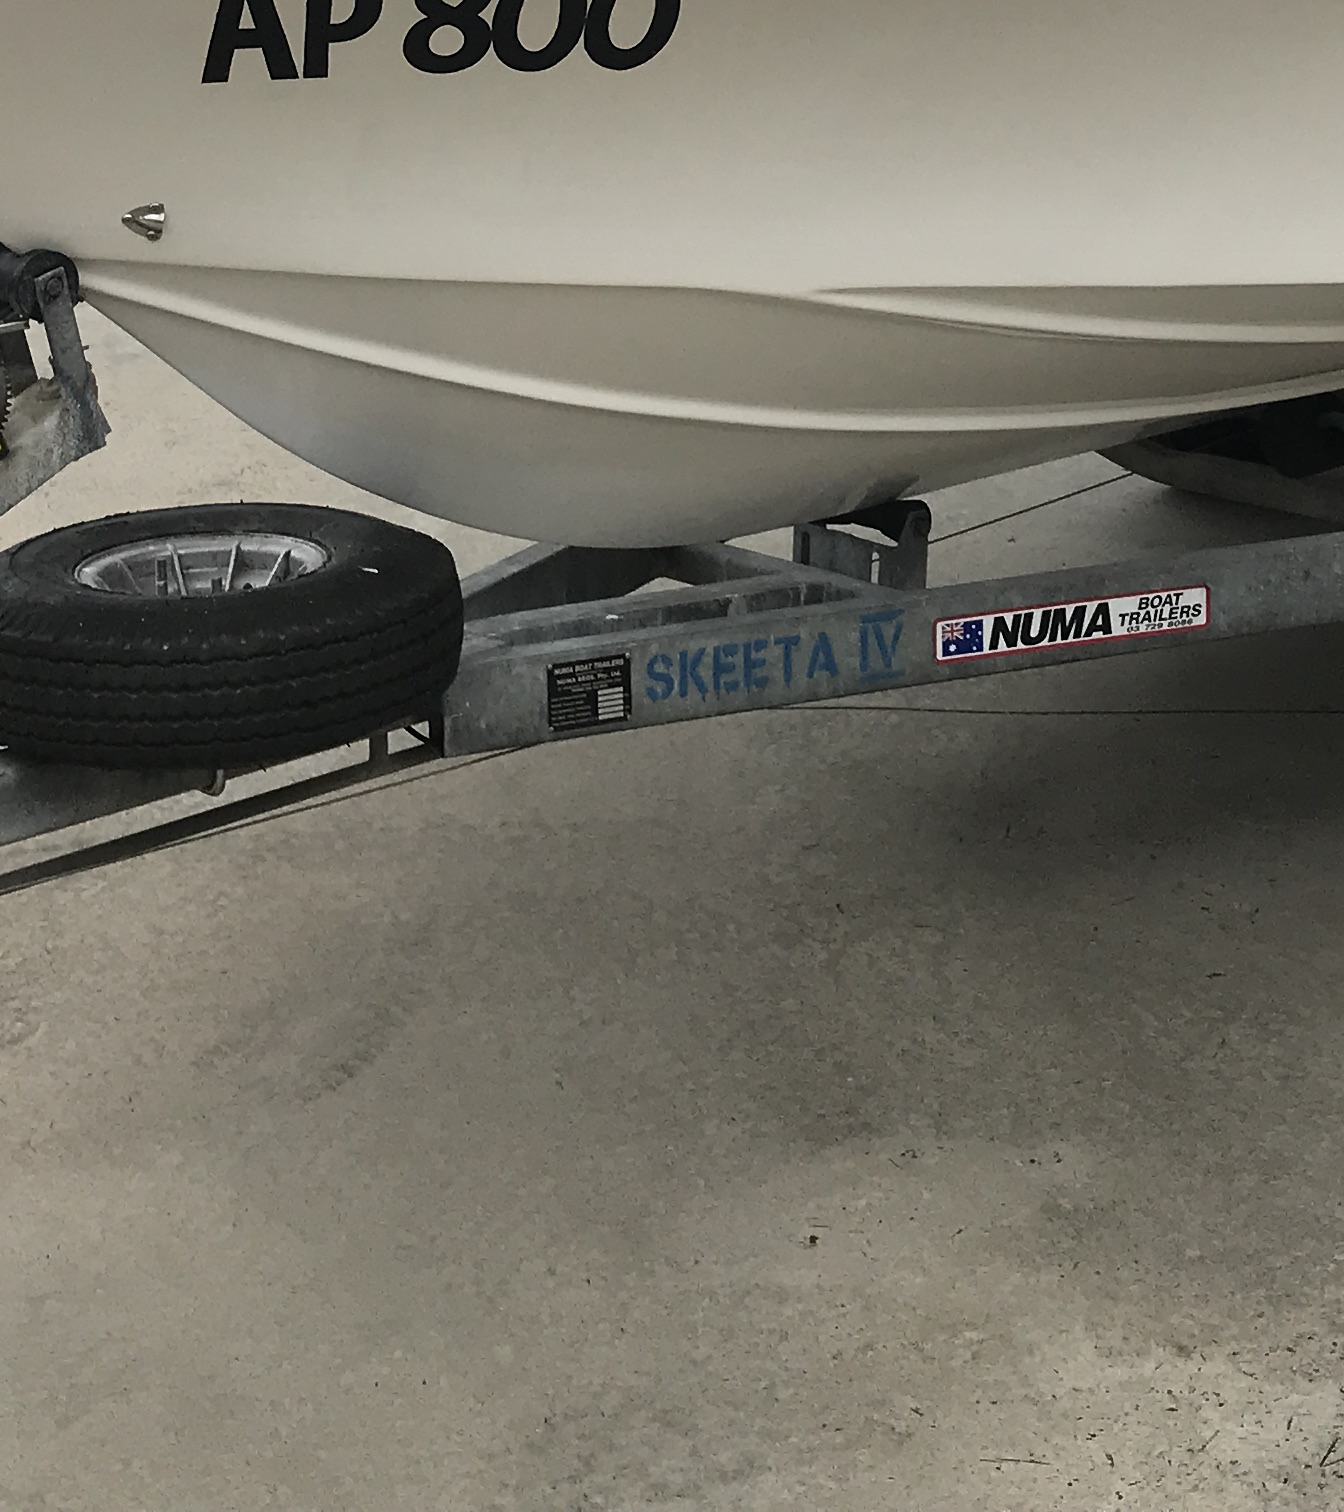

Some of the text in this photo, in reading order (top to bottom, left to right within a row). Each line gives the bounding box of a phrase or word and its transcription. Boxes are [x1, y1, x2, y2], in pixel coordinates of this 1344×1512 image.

[1118, 603, 1202, 627] TRAILERS
[1138, 592, 1184, 611] BOAT
[989, 601, 1113, 651] NUMA
[646, 608, 906, 704] SKEETA IV
